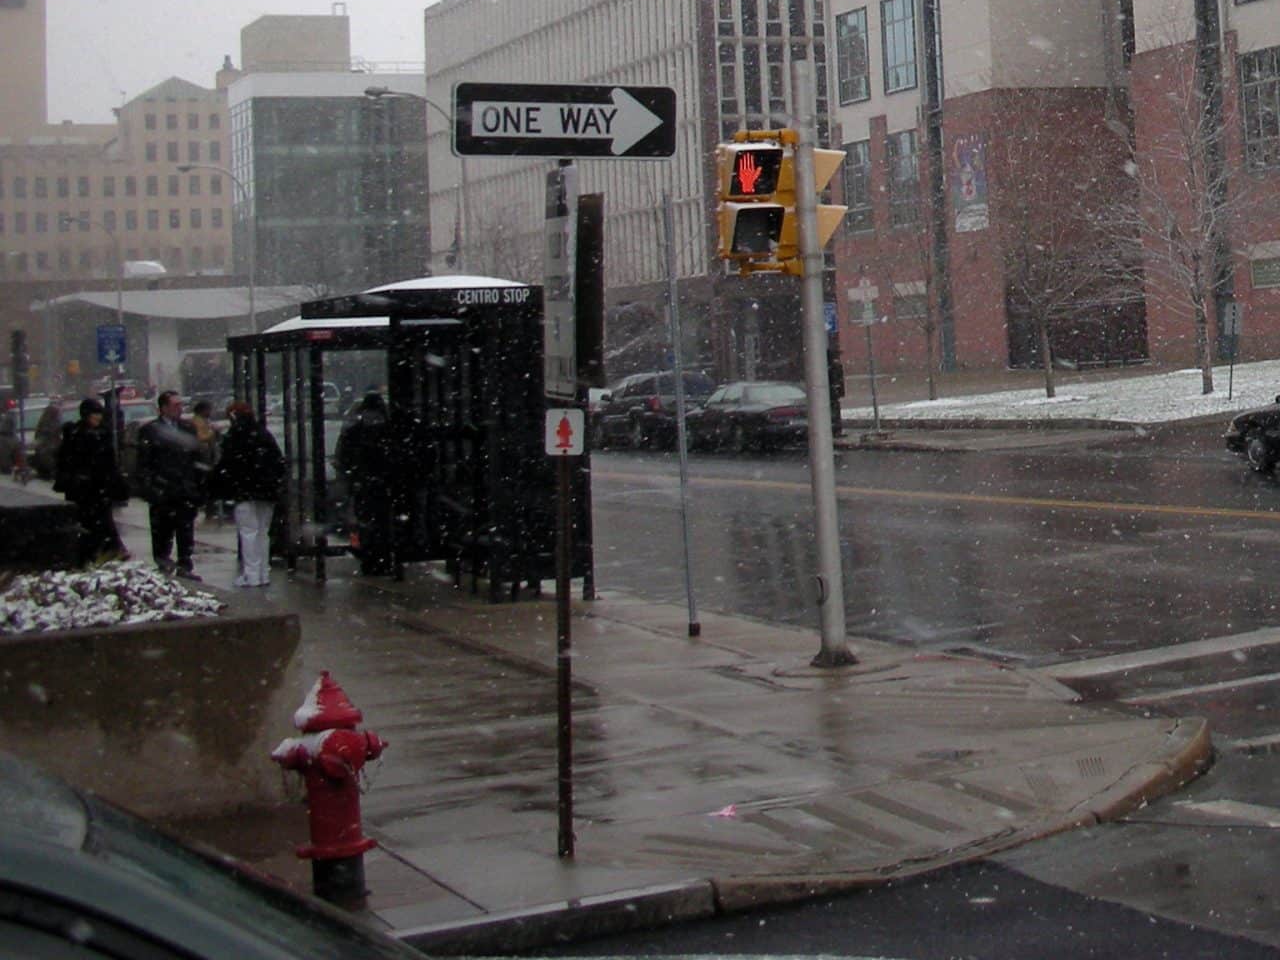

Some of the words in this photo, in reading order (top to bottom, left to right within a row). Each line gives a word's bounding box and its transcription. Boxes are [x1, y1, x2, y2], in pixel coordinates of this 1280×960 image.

[482, 106, 541, 133] ONE
[560, 107, 618, 134] WAY
[457, 289, 500, 305] CENTRO
[503, 288, 530, 303] STOP
